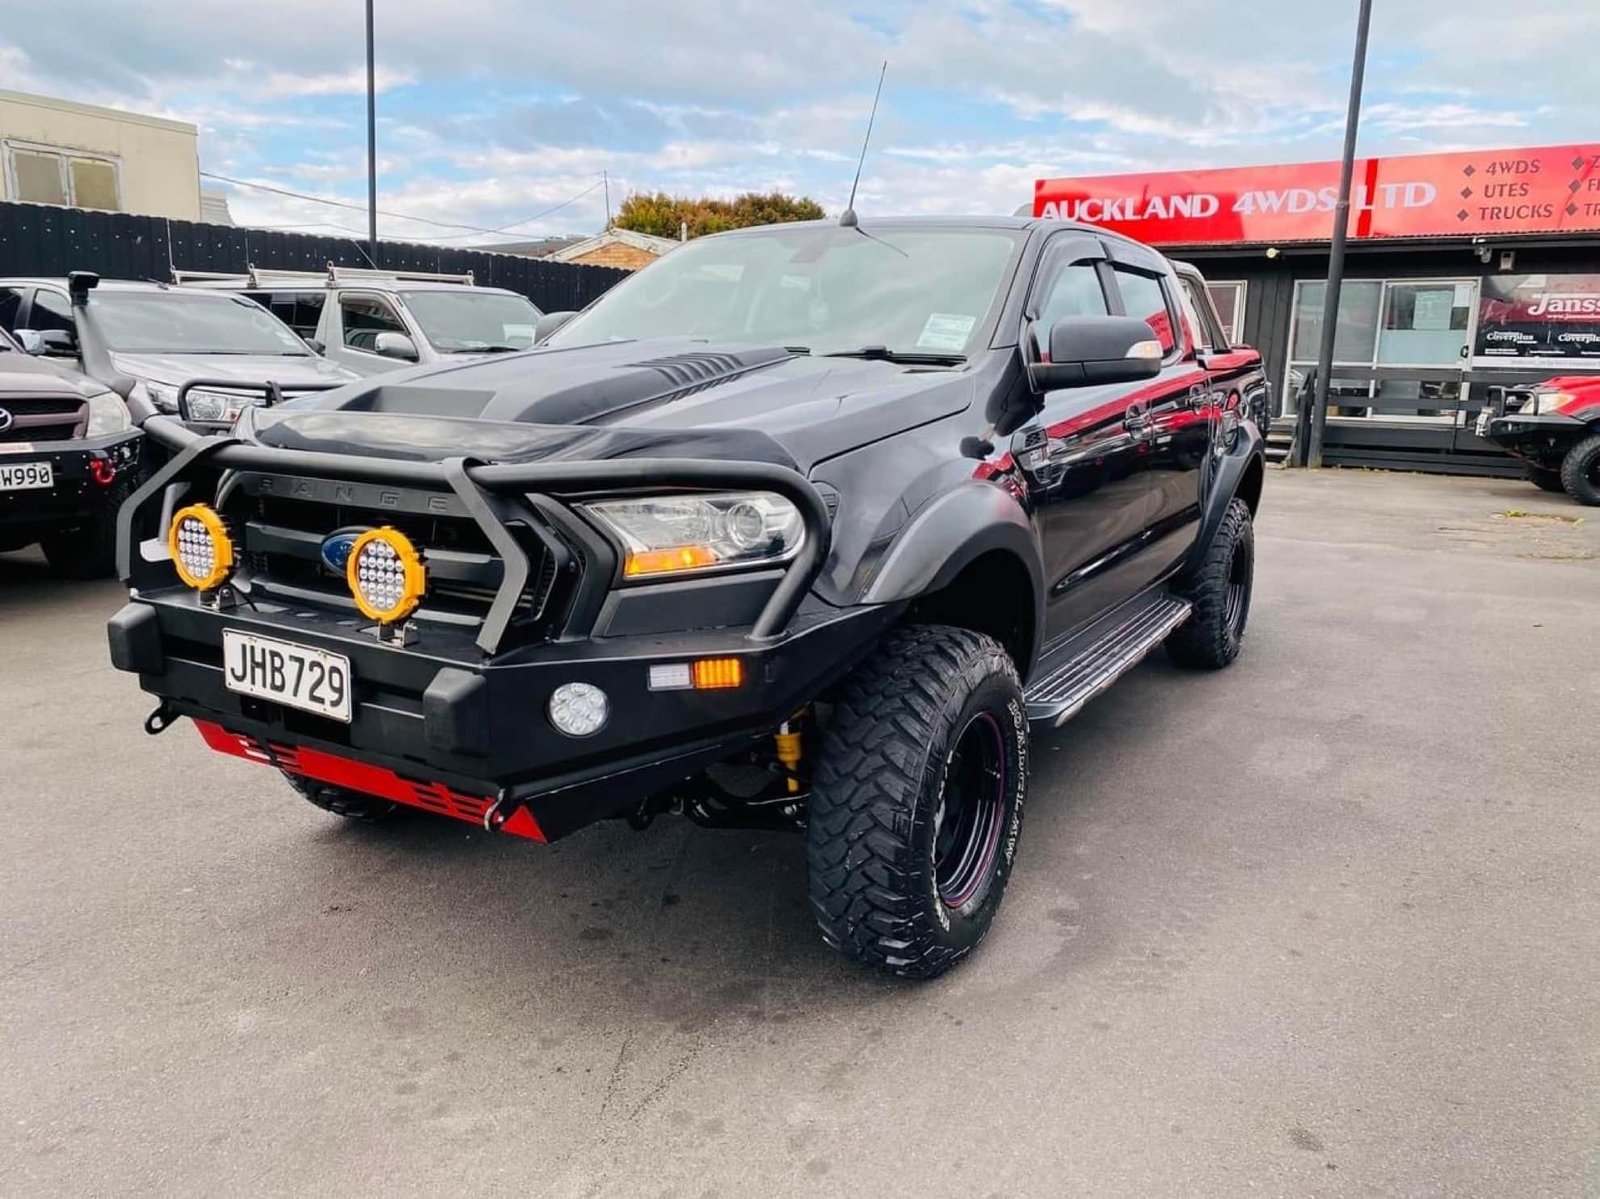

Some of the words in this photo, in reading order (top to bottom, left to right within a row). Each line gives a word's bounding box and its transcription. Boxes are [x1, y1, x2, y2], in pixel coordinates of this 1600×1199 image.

[1486, 159, 1541, 174] 4WDS
[1041, 193, 1220, 222] AUCKLAND
[1231, 187, 1338, 215] 4WDS
[1355, 182, 1437, 210] LTD
[1484, 182, 1529, 198] UTES
[1479, 203, 1554, 221] TRUCKS
[260, 477, 449, 511] RANGE
[230, 643, 344, 708] JHB729
